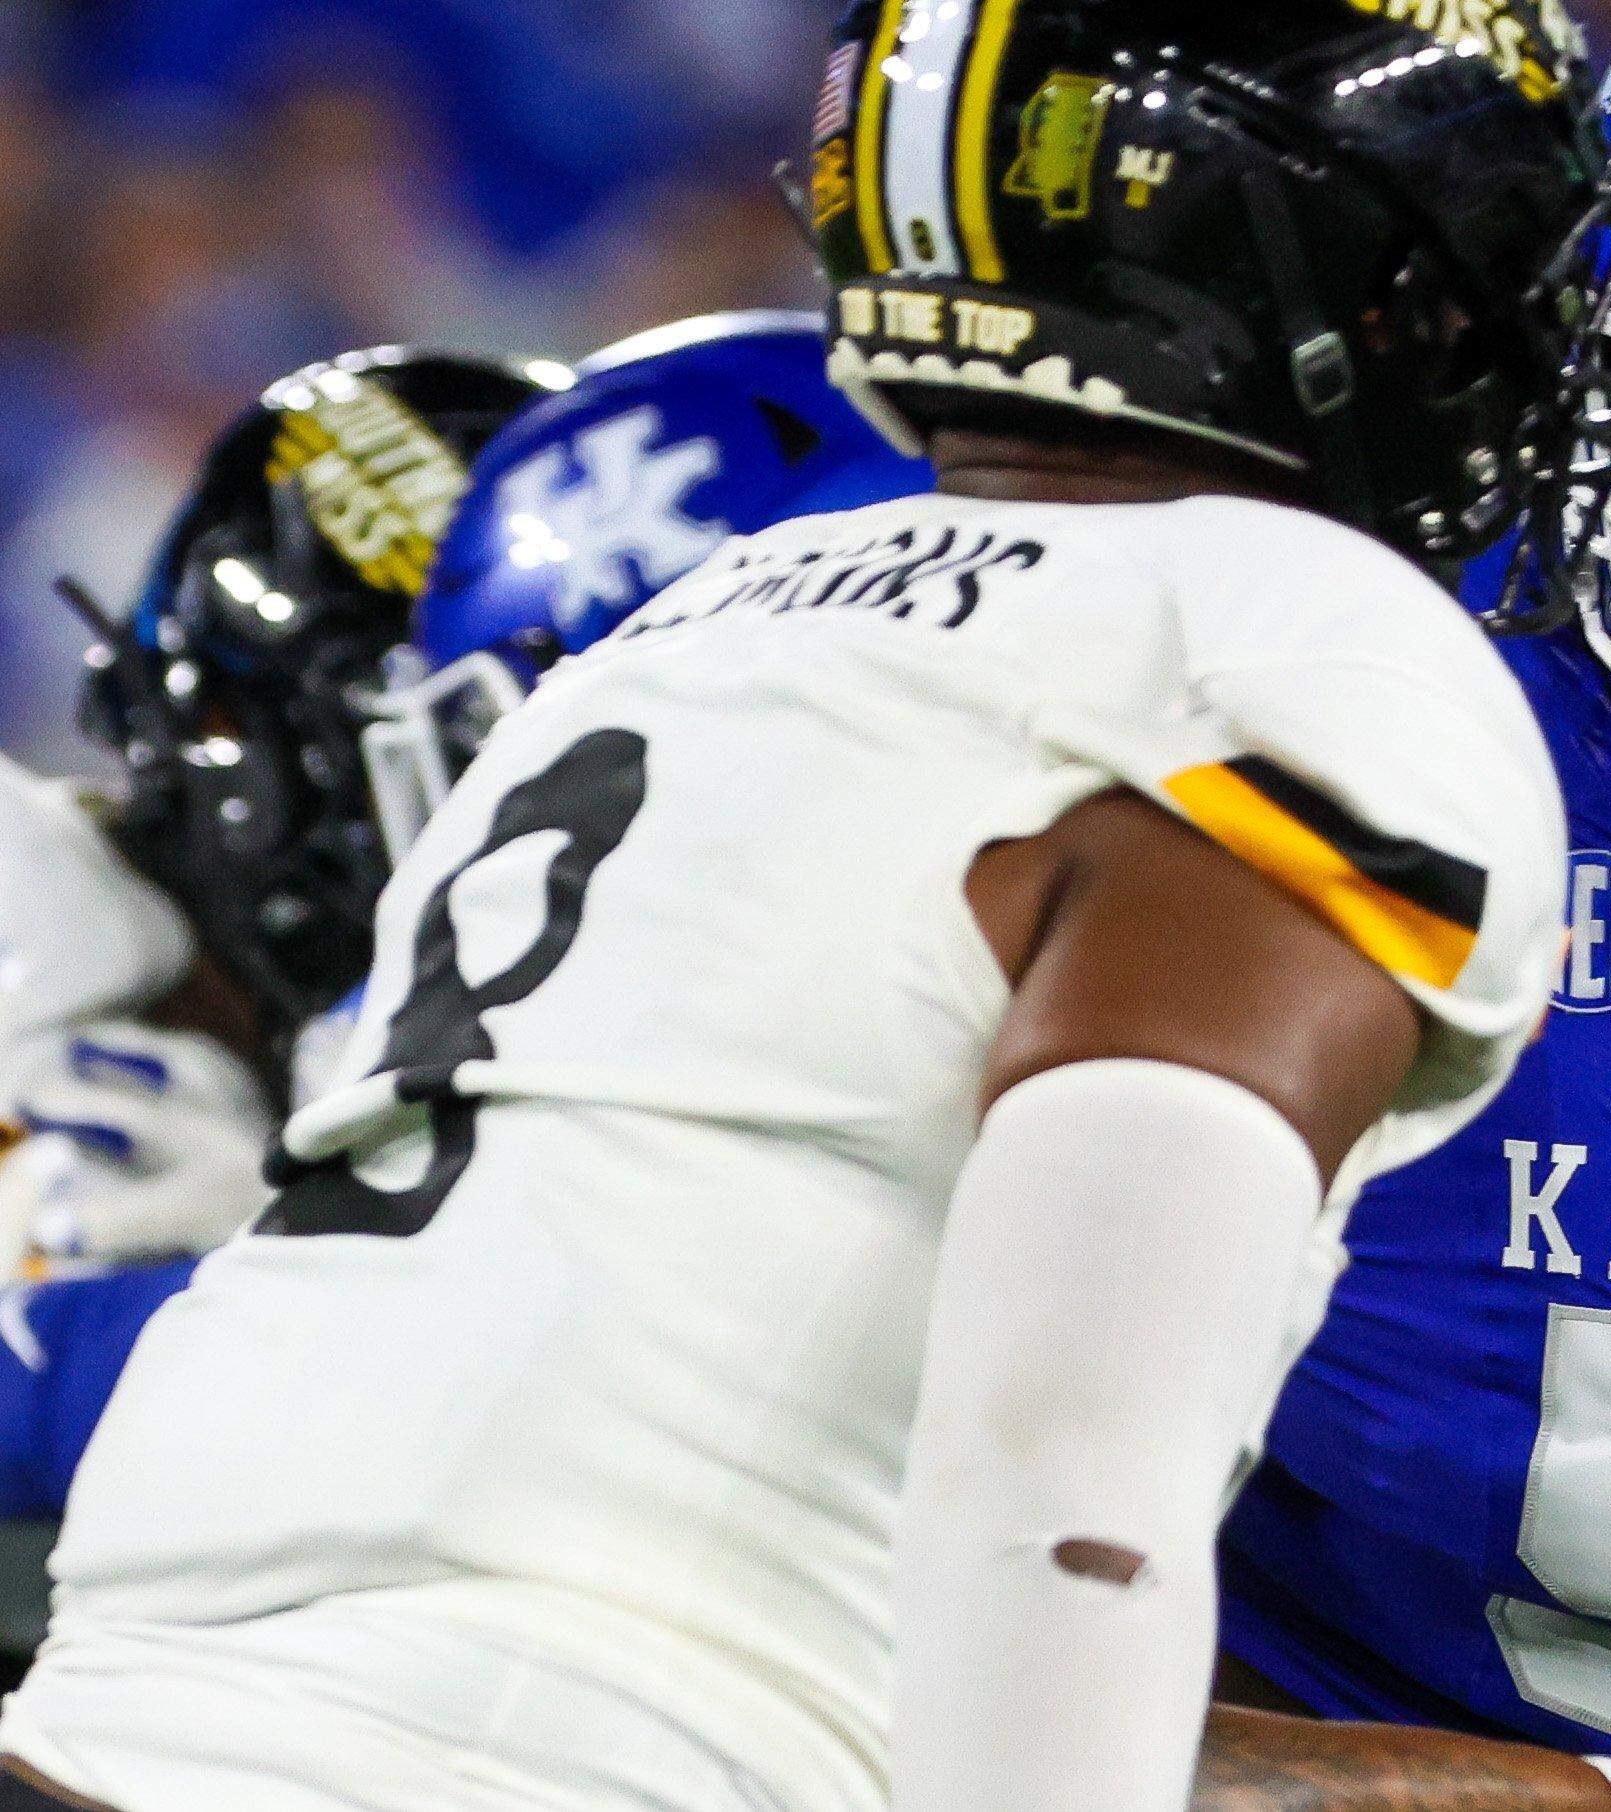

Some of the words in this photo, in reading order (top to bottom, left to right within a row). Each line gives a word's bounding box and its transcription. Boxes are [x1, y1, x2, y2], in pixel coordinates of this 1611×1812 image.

[878, 288, 946, 343] THE
[950, 299, 1038, 356] TOP
[252, 727, 648, 1237] 8
